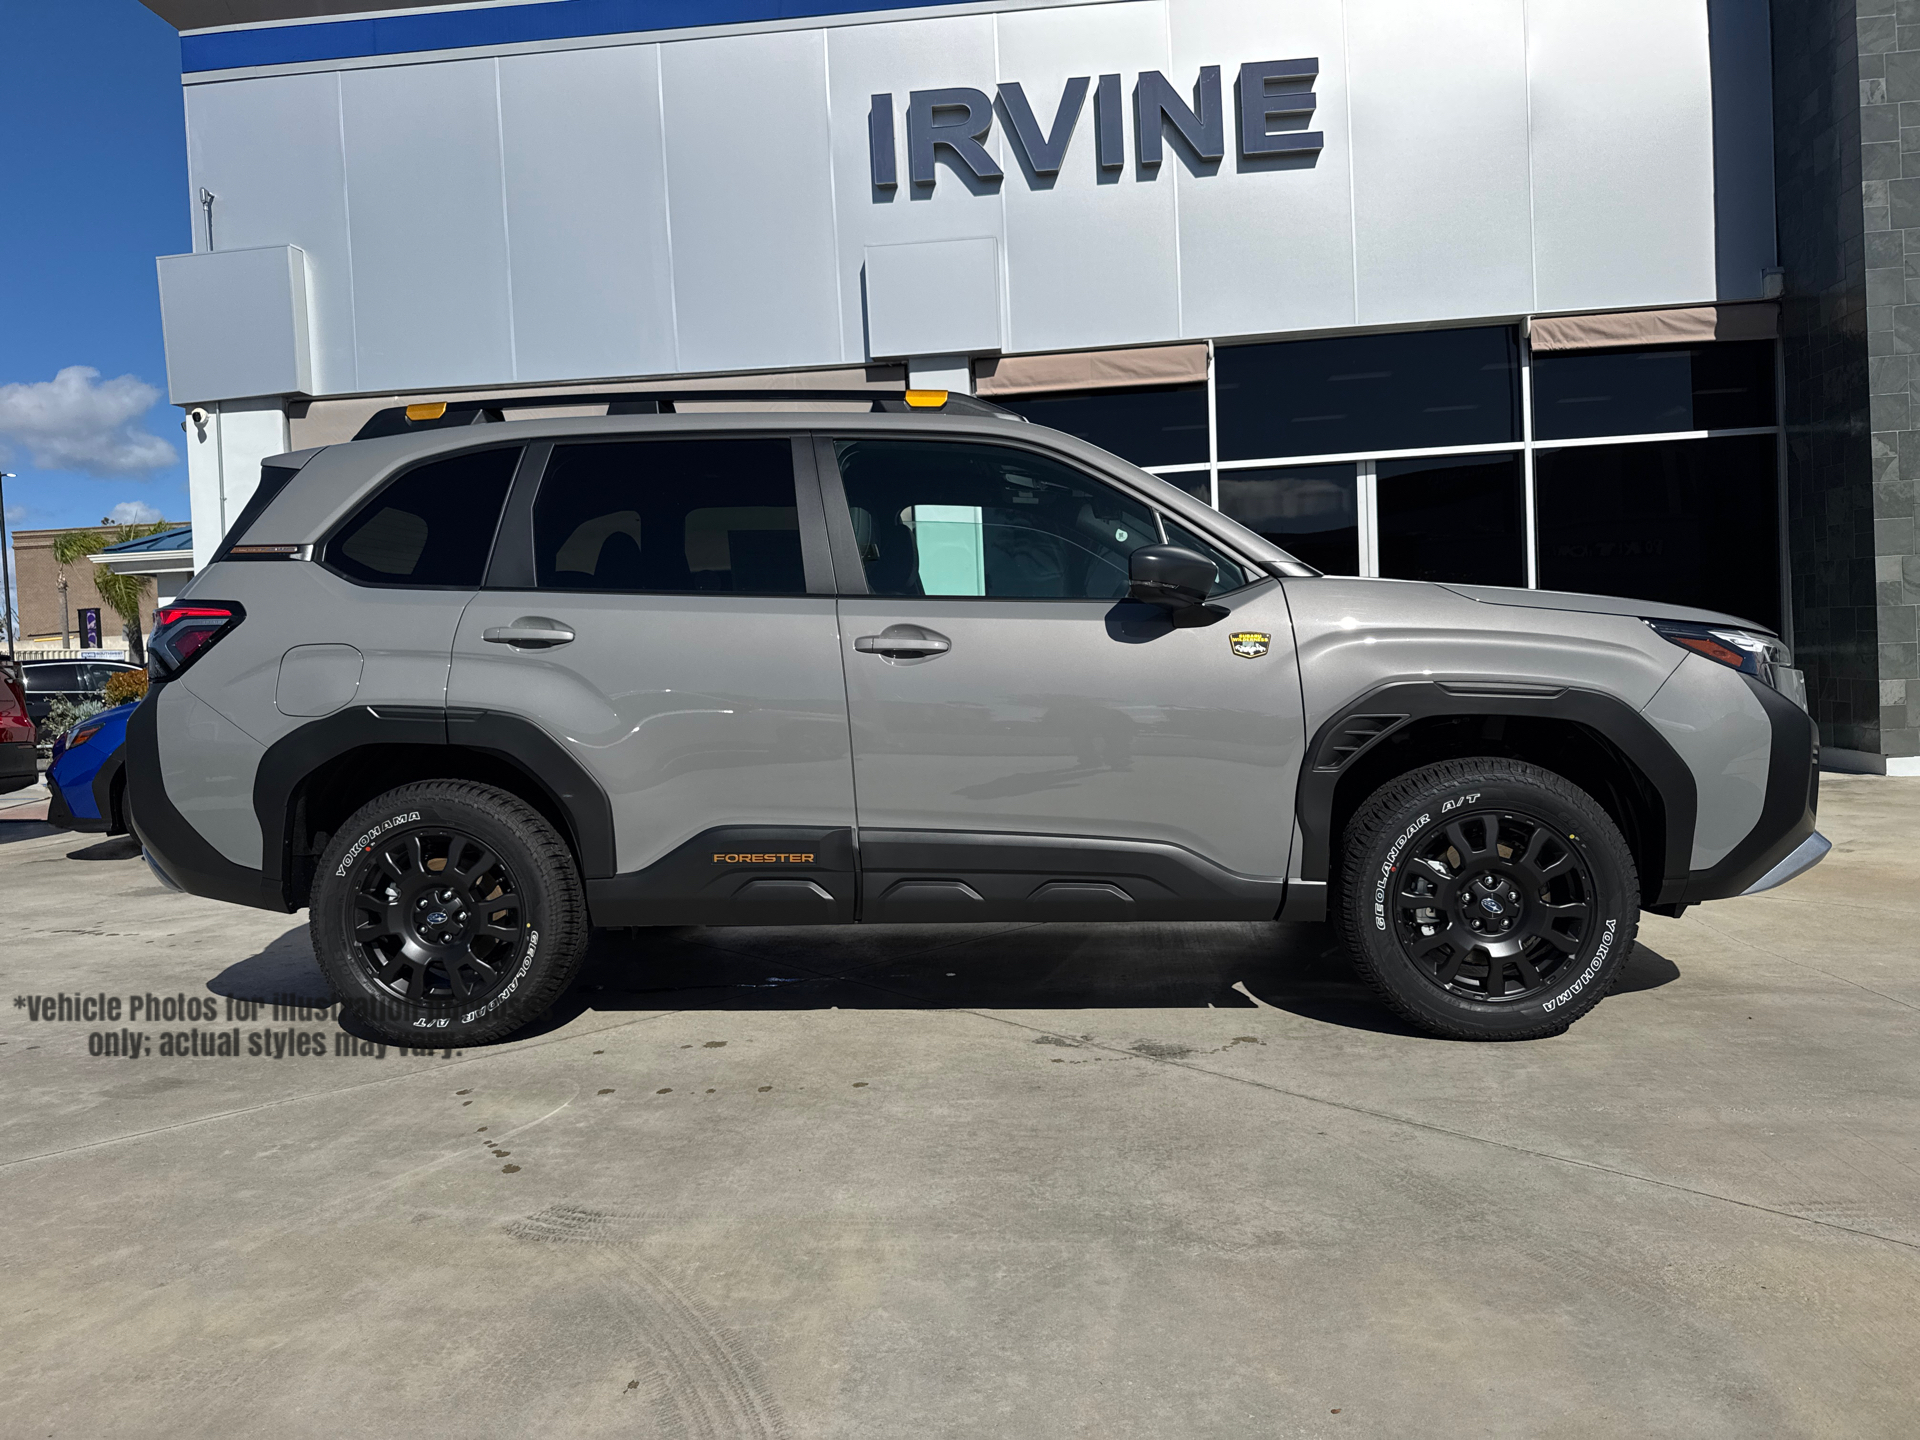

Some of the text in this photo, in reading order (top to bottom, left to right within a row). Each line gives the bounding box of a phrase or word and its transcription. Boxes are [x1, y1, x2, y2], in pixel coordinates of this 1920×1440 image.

[869, 57, 1324, 196] IRVINE
[336, 811, 421, 878] YOKOHAMA
[713, 853, 815, 864] FORESTER
[1374, 793, 1481, 930] GEOLANDAR A/T
[461, 930, 539, 1024] GEOLANDAR
[1542, 918, 1617, 1012] YOKOHAMA
